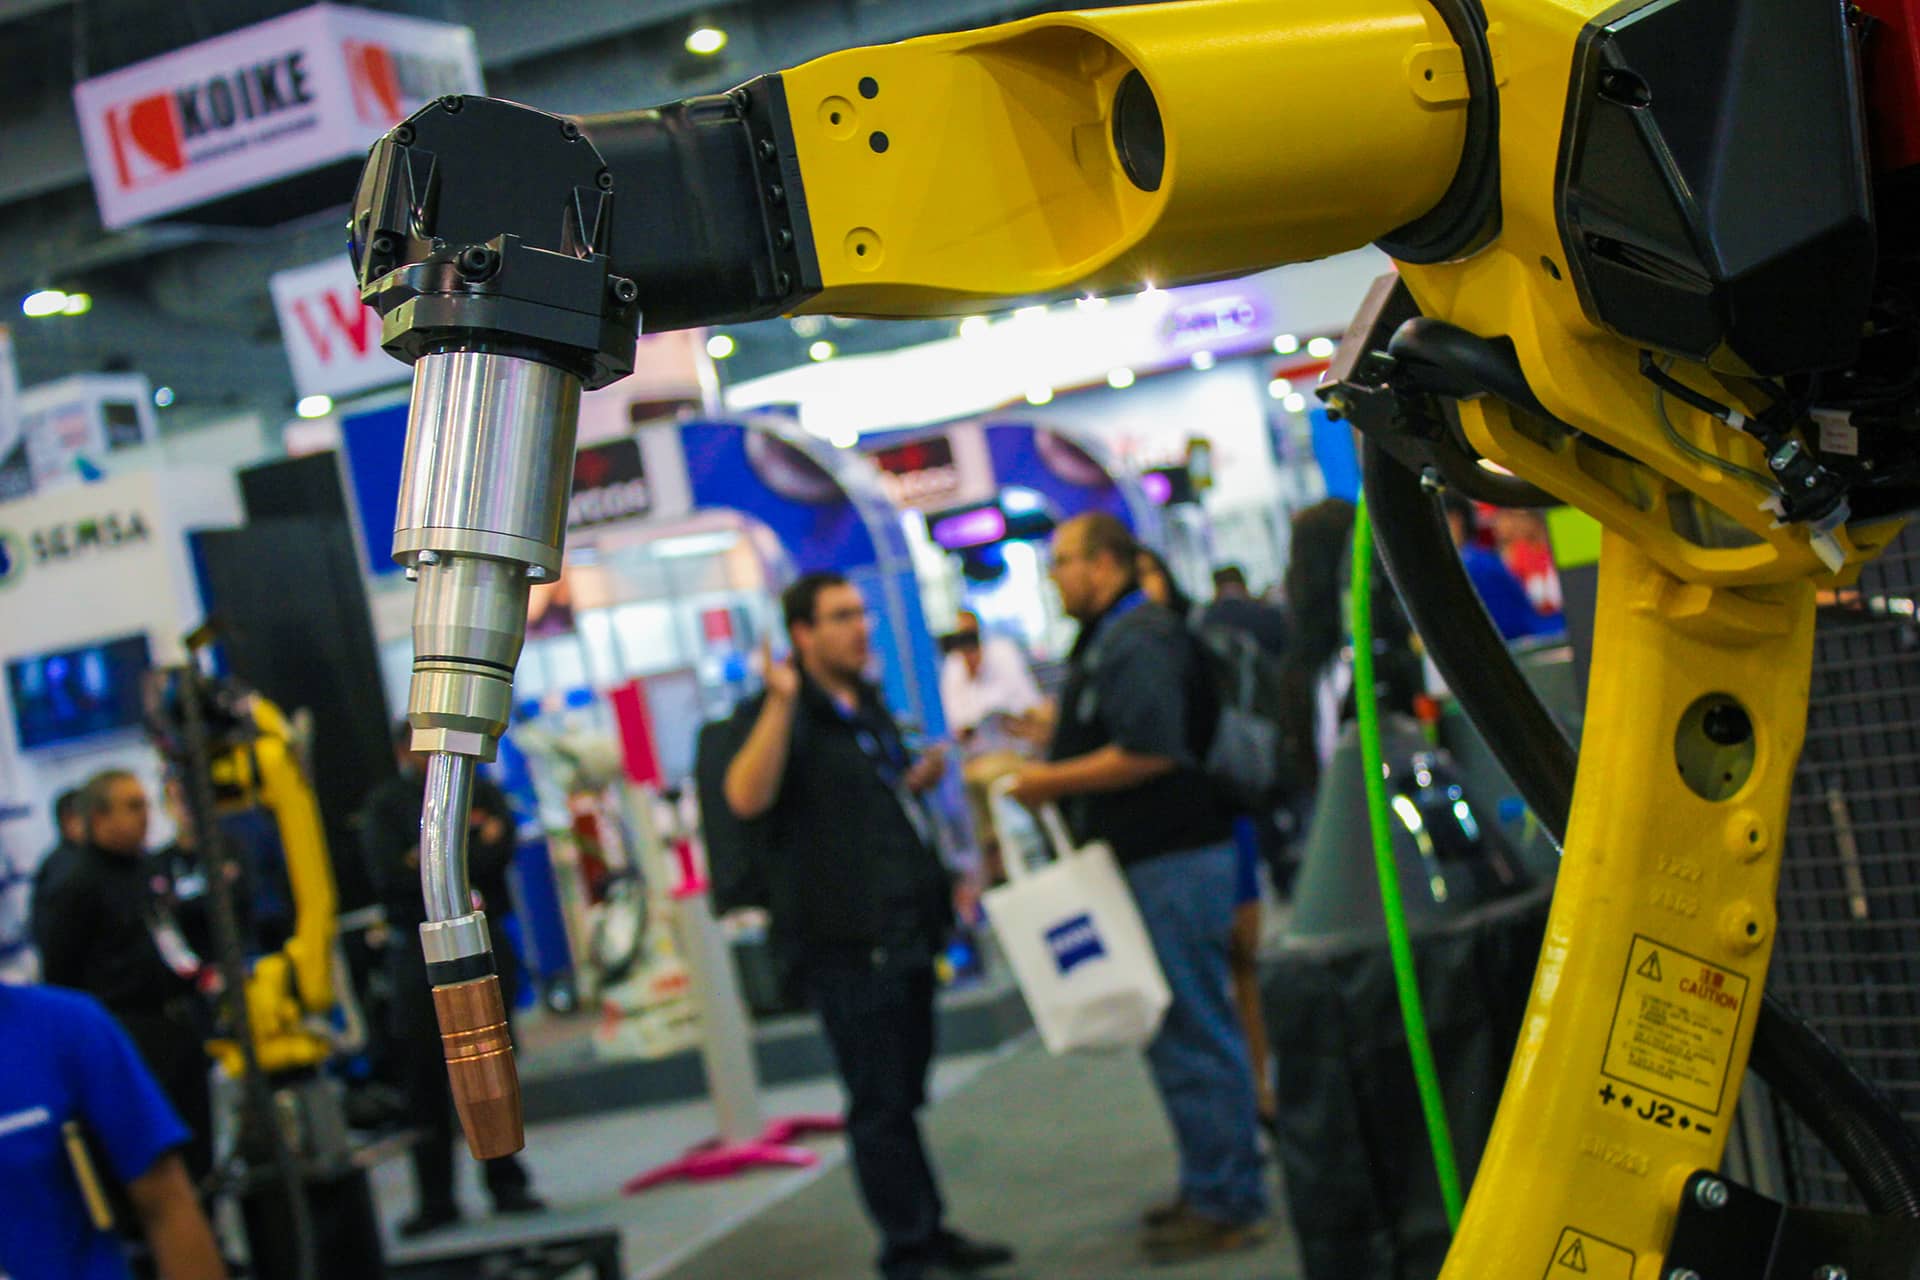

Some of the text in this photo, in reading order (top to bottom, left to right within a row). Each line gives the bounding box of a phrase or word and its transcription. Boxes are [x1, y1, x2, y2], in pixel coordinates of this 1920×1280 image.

[173, 47, 314, 139] KOIKE
[29, 511, 151, 562] SEMSA
[1678, 976, 1739, 1013] CAUTION
